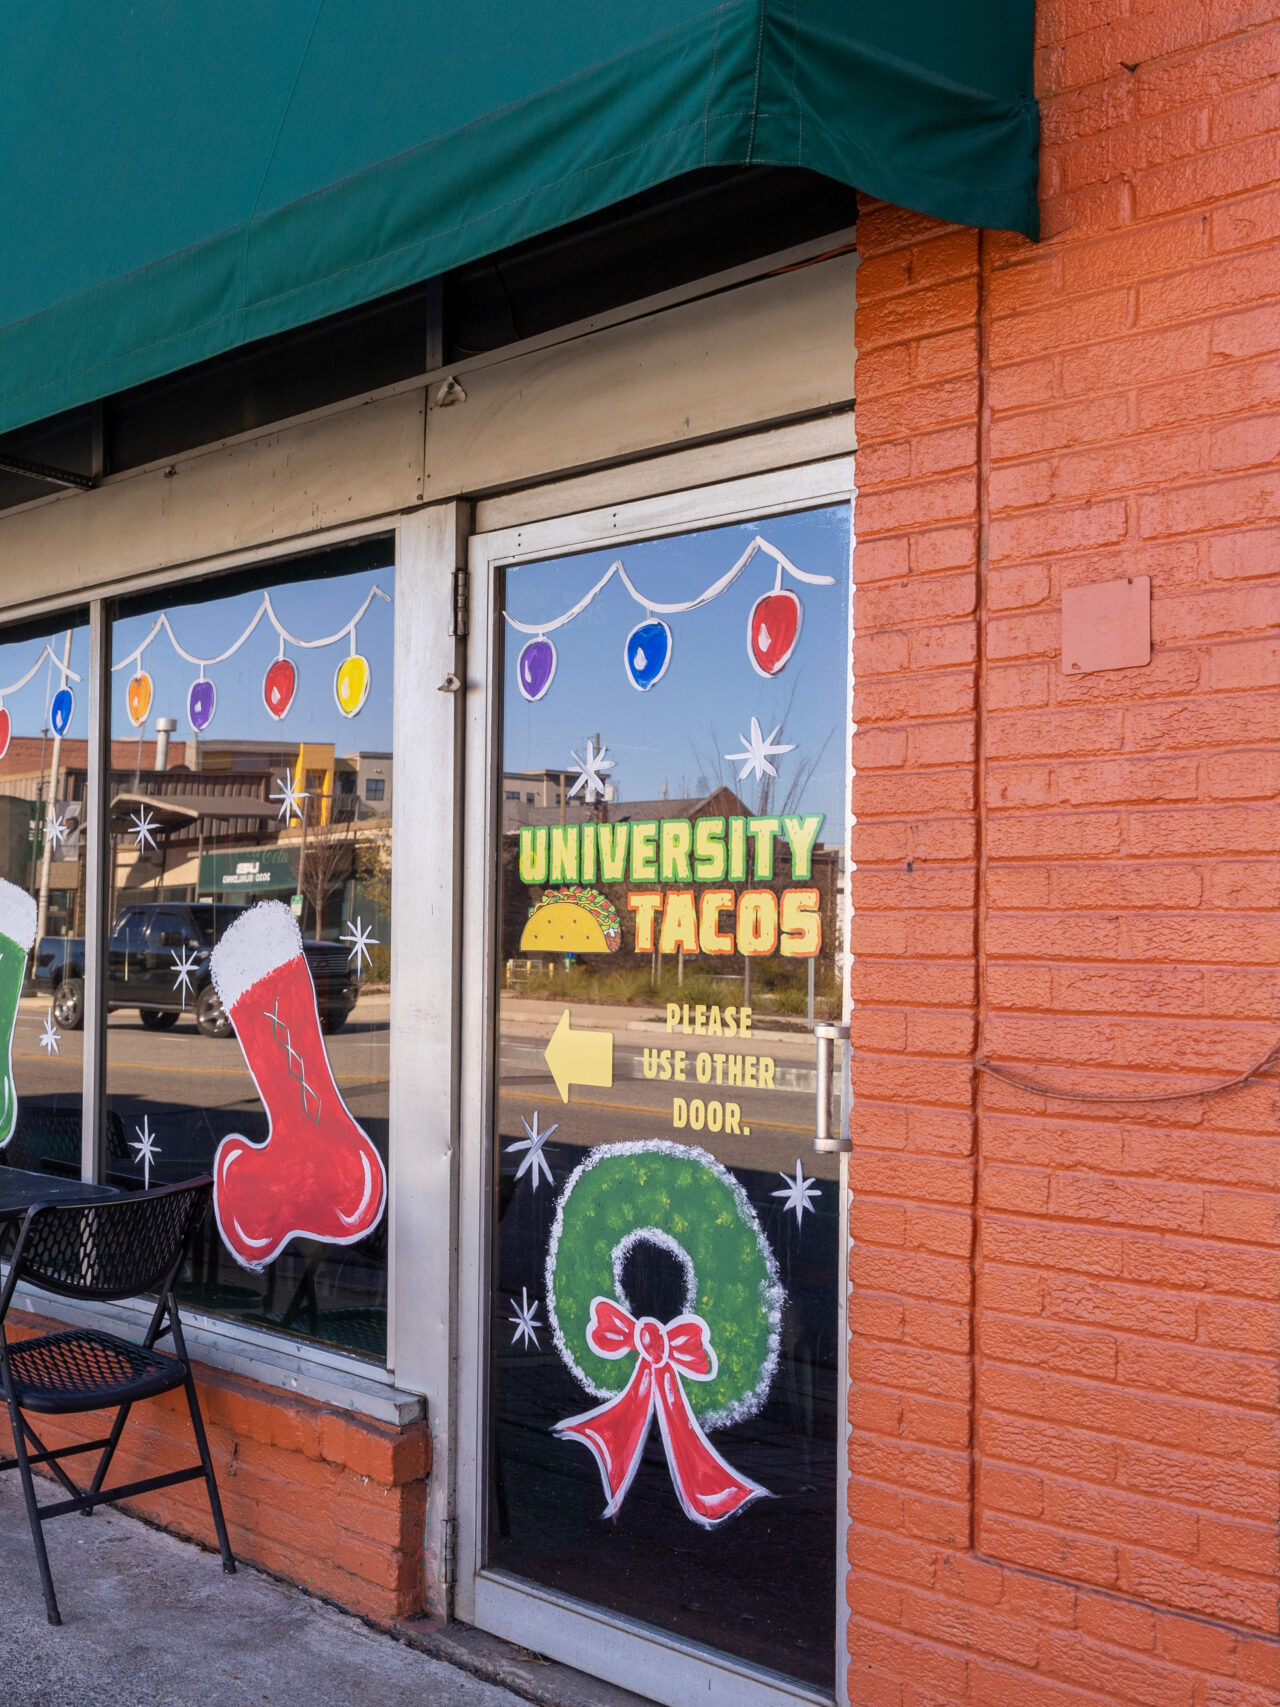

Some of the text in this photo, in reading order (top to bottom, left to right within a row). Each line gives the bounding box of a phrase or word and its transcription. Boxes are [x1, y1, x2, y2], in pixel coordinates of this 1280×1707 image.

[519, 812, 825, 884] UNIVERSITY
[627, 888, 822, 957] TACOS
[666, 1002, 753, 1038] PLEASE
[643, 1047, 776, 1089] USE OTHER
[672, 1097, 751, 1136] DOOR.
